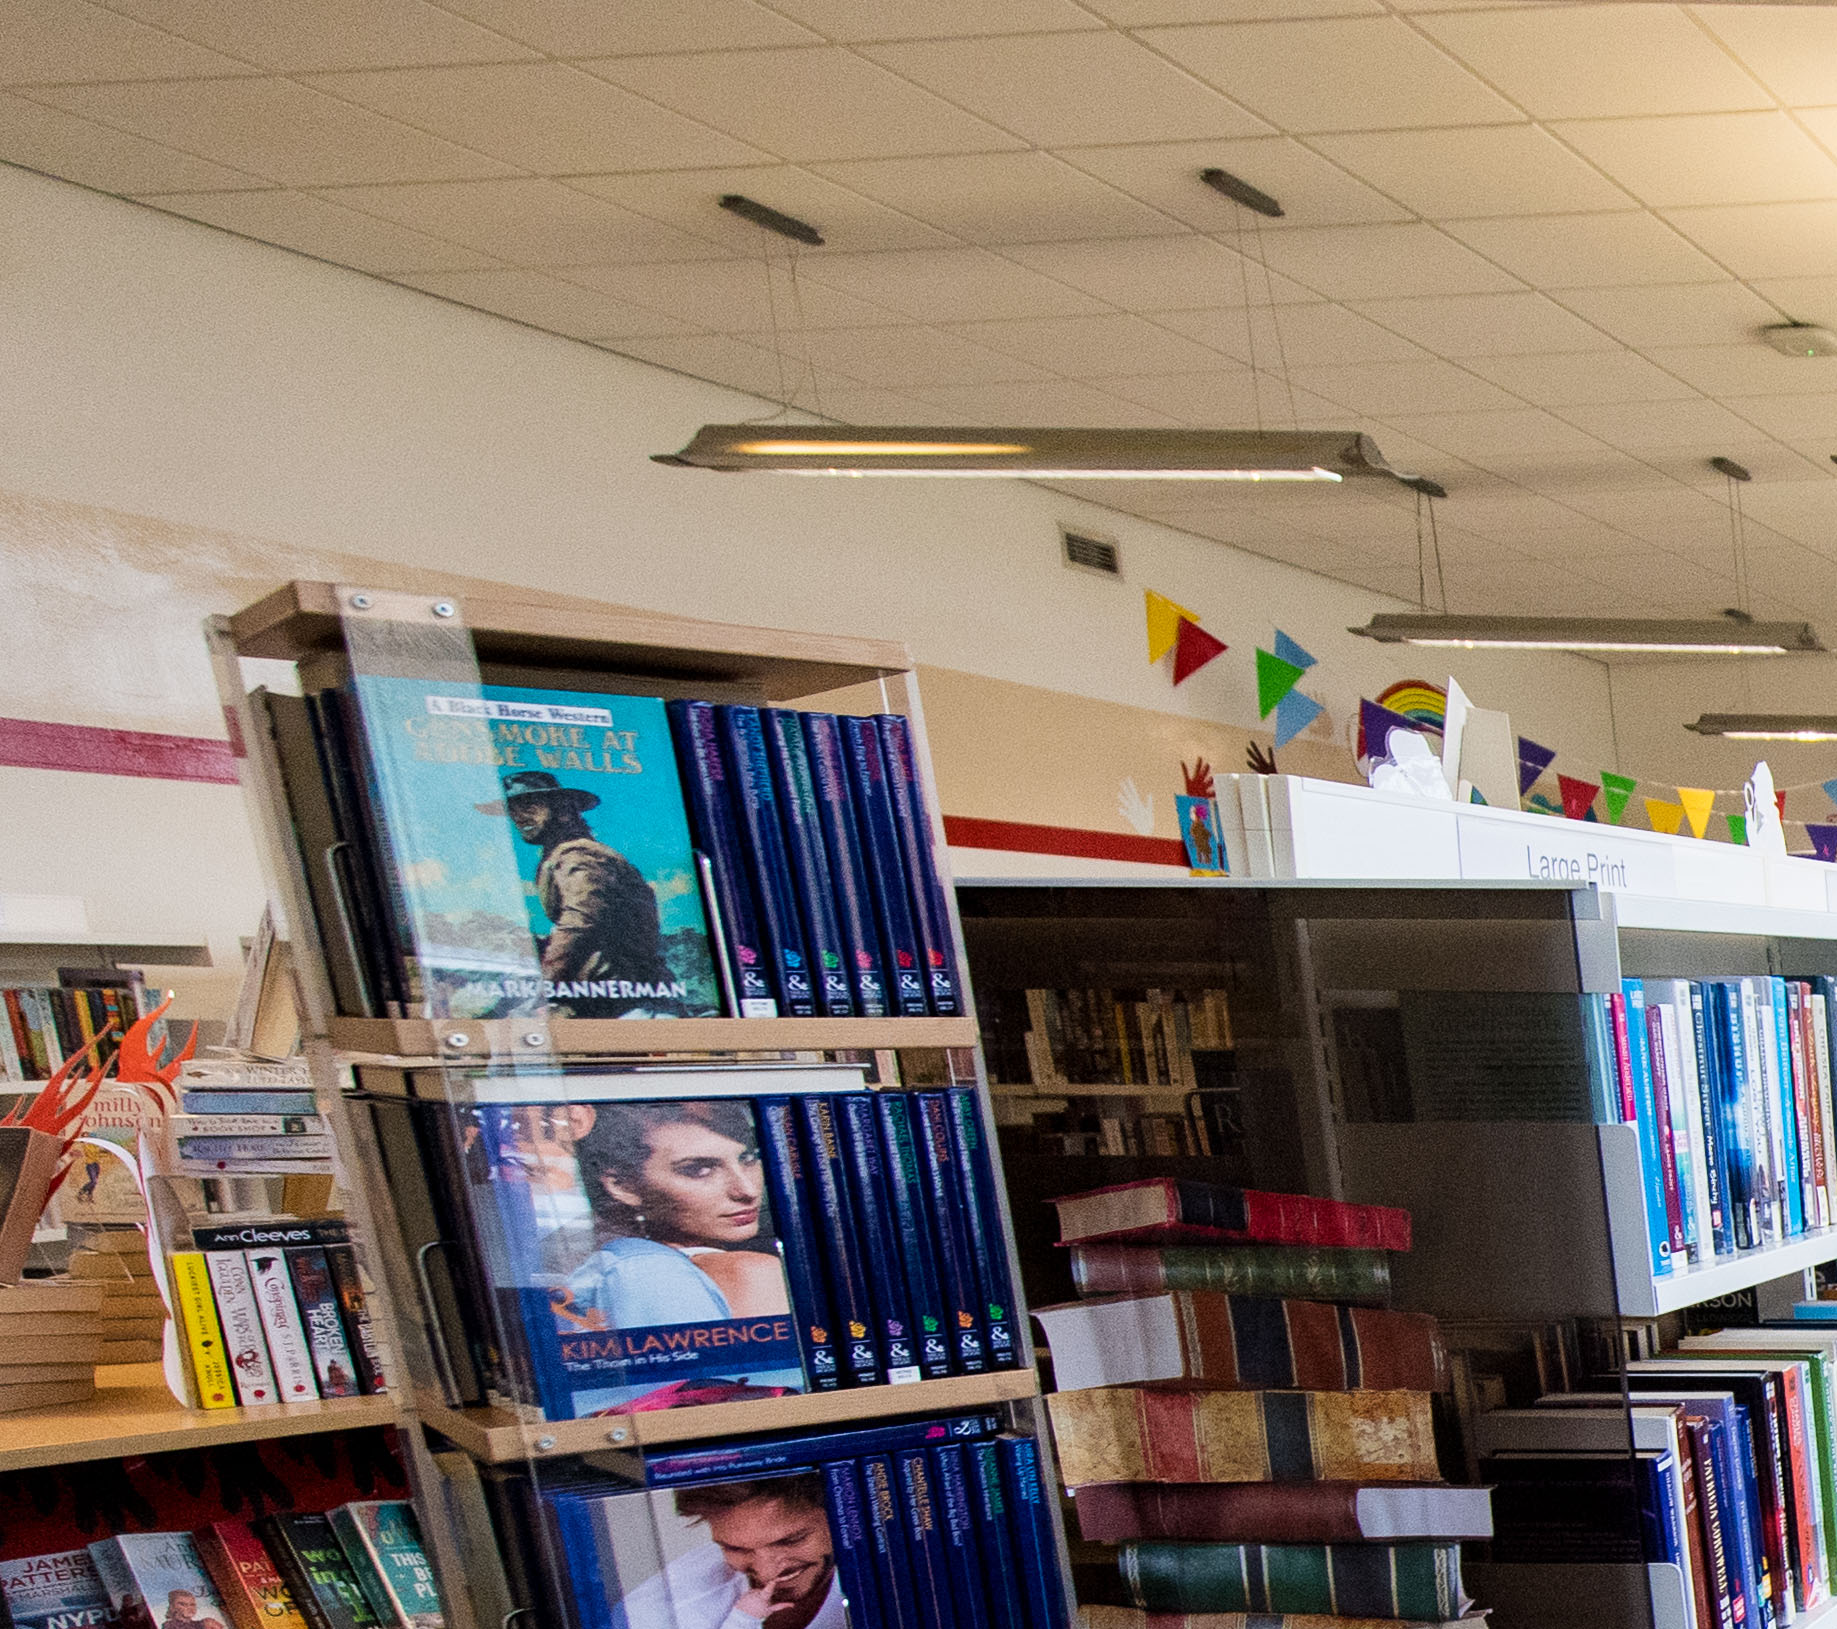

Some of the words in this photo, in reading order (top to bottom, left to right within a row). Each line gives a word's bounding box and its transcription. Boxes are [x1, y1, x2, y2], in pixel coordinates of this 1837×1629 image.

[448, 698, 490, 716] Black
[497, 702, 544, 721] Horse
[550, 705, 611, 725] Western
[602, 727, 640, 755] AT
[535, 744, 645, 777] WALLS
[1528, 846, 1582, 882] Large
[1588, 853, 1627, 889] Print
[466, 978, 540, 998] MARK
[544, 976, 688, 1003] BANNERMAN
[1619, 1034, 1629, 1060] Susan
[1693, 1011, 1708, 1079] Chestnut
[1622, 1062, 1633, 1101] Andersen
[93, 1096, 145, 1119] milly
[1700, 1083, 1712, 1126] Street
[892, 1100, 910, 1142] RACHAEL
[901, 1145, 918, 1184] THOMAS
[931, 1124, 949, 1162] COLLINS
[964, 1119, 978, 1150] GREEN
[240, 1226, 311, 1243] Cleeves
[264, 1276, 290, 1331] Conspiracy
[307, 1307, 330, 1351] HEART
[318, 1301, 345, 1354] BROKEN
[560, 1338, 622, 1360] KIM
[624, 1321, 791, 1355] LAWRENCE
[567, 1360, 593, 1371] The
[595, 1356, 633, 1368] Thorn
[634, 1355, 647, 1364] in
[649, 1352, 671, 1363] His
[672, 1349, 700, 1361] Side
[1022, 1443, 1034, 1464] MIRA
[874, 1462, 888, 1489] ANDIE
[911, 1456, 930, 1505] CHANTELLE
[1025, 1465, 1036, 1481] LYN
[1700, 1457, 1721, 1520] PATRICIA
[879, 1489, 894, 1520] BROCK
[951, 1472, 970, 1529] HARRINGTON
[1028, 1481, 1040, 1504] KELLY
[848, 1504, 863, 1540] LENNOX
[920, 1505, 934, 1531] SHAW
[391, 1553, 427, 1569] THIS
[1707, 1521, 1731, 1593] CORNWELL
